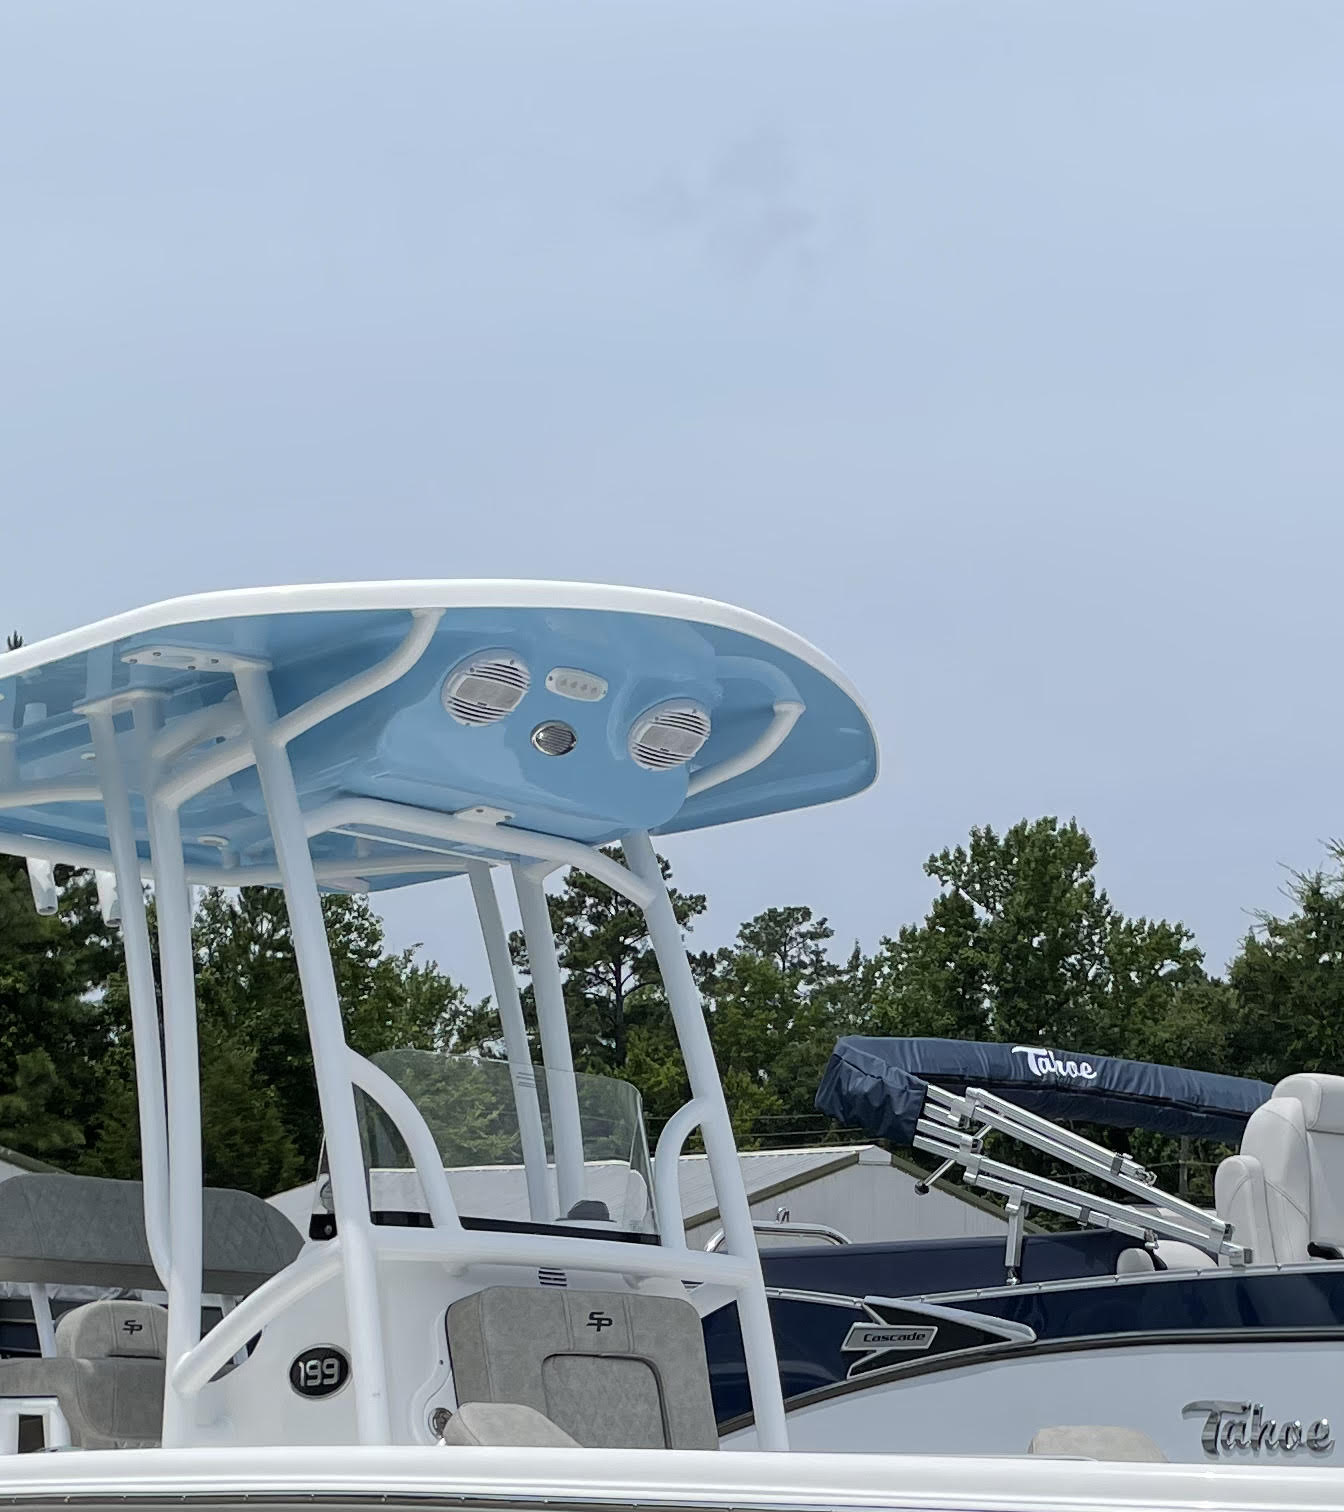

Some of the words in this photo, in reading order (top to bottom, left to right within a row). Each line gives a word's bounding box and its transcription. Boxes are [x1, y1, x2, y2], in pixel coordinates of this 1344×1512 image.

[1011, 1046, 1097, 1079] Tahoe
[863, 1332, 926, 1343] Cascade
[298, 1358, 340, 1387] 199
[1181, 1400, 1335, 1457] Tahoe
